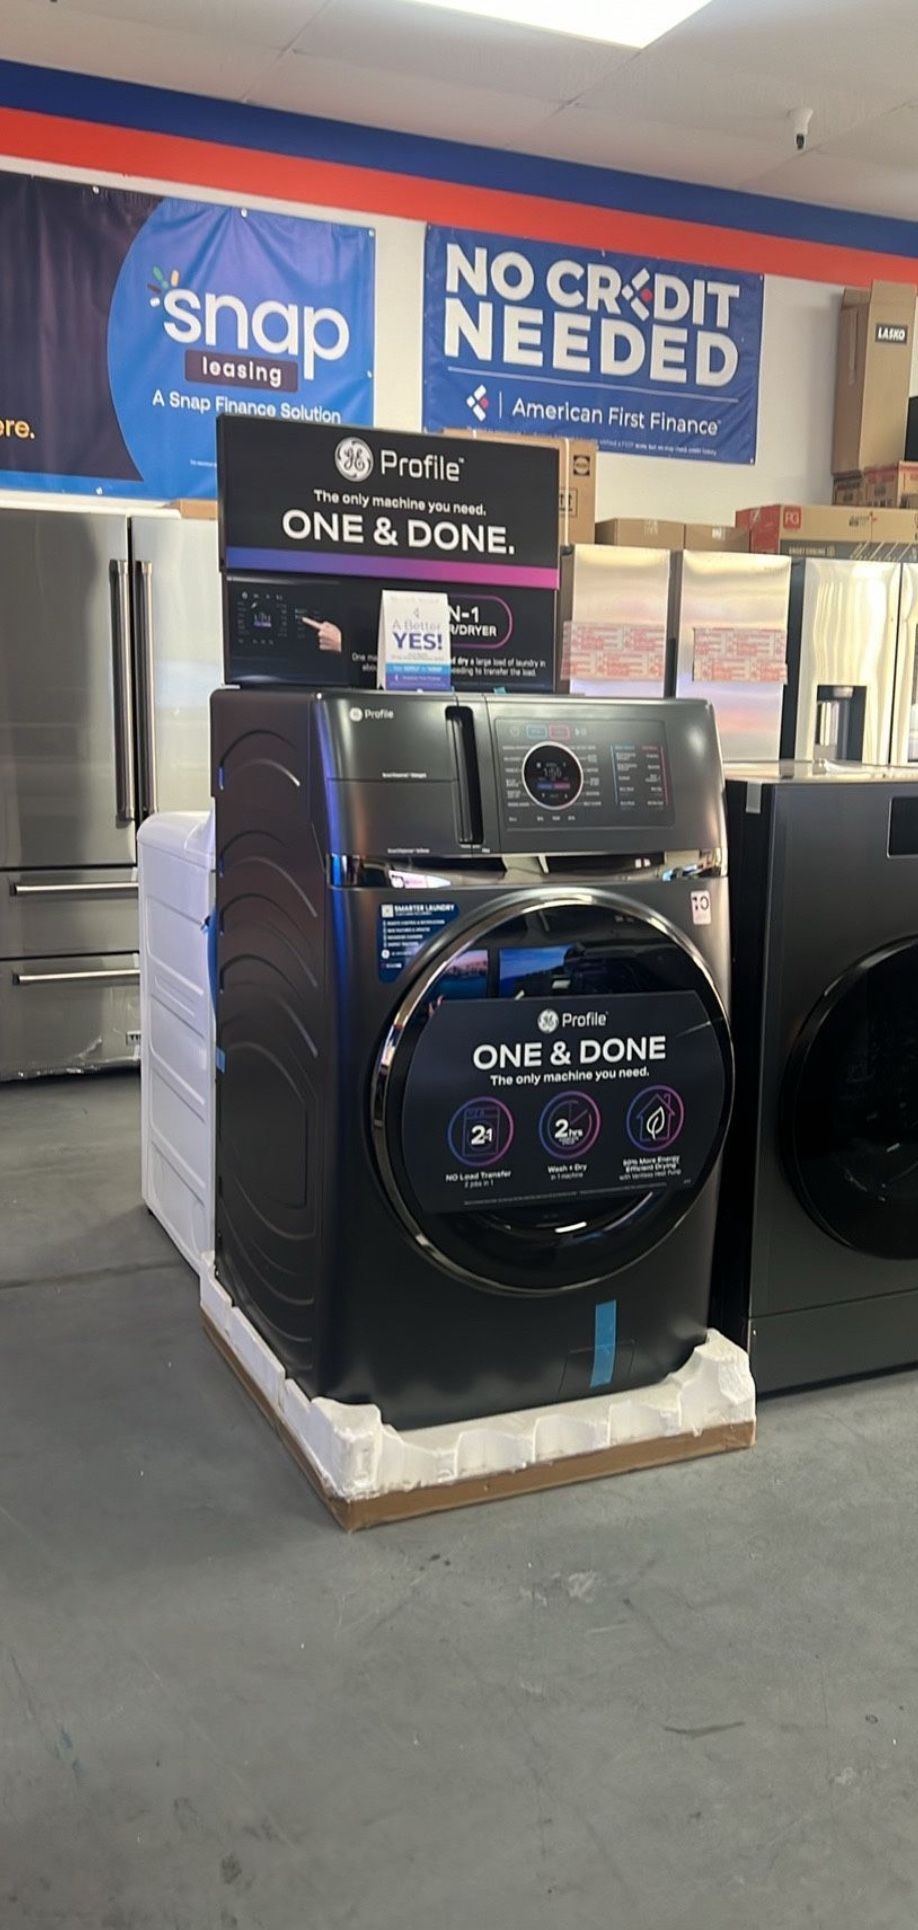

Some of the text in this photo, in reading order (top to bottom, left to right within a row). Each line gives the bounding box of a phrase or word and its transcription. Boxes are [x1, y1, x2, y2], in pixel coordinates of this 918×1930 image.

[445, 243, 536, 302] NO
[163, 288, 350, 381] snap
[444, 297, 739, 388] NEEDED
[877, 326, 906, 342] LASKO
[202, 356, 282, 387] leasing
[152, 390, 341, 424] A Snap Finance Solution
[511, 397, 719, 437] American First Finance
[313, 489, 487, 517] The only machine you need.
[282, 509, 516, 556] ONE & DONE.
[404, 620, 441, 631] Better
[447, 605, 480, 623] N-1
[393, 631, 443, 651] YES!
[449, 623, 497, 637] R/DRYER
[364, 708, 394, 720] Profile
[473, 1036, 667, 1070] ONE & DONE
[490, 1067, 650, 1088] The only machine you need.
[480, 1170, 512, 1180] Transfer
[574, 1163, 588, 1173] Dry
